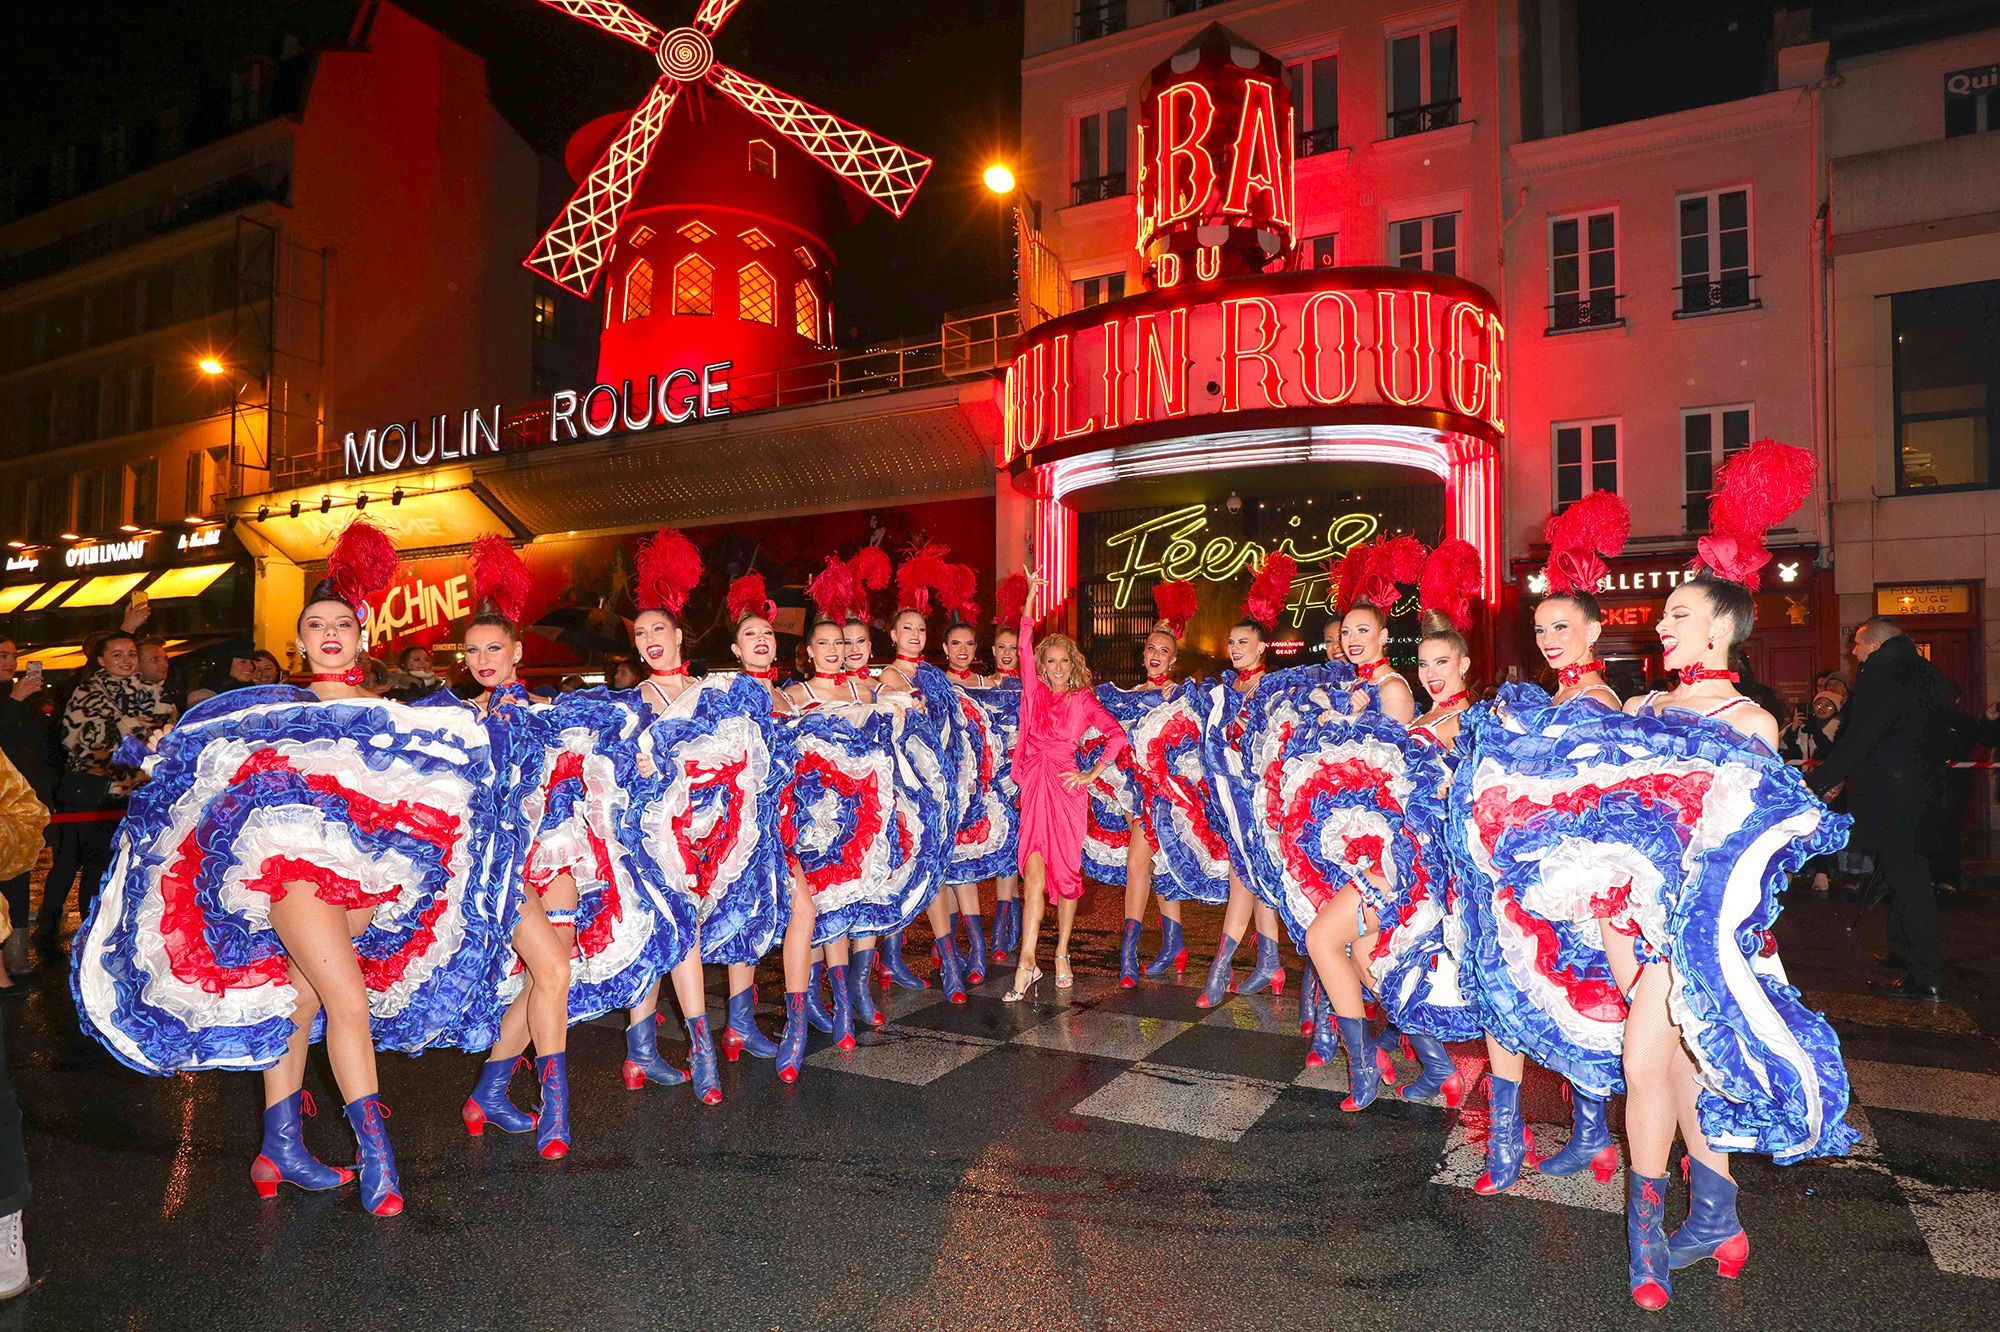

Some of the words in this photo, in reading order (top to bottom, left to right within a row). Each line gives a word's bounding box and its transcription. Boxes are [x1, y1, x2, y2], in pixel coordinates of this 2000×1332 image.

[1947, 66, 2000, 95] Qui
[1157, 246, 1219, 287] DU
[1005, 308, 1186, 463] OULIN
[1221, 290, 1505, 433] ROUGE
[344, 404, 501, 475] MOULIN
[552, 361, 732, 442] ROUGE
[1600, 606, 1653, 626] CKET
